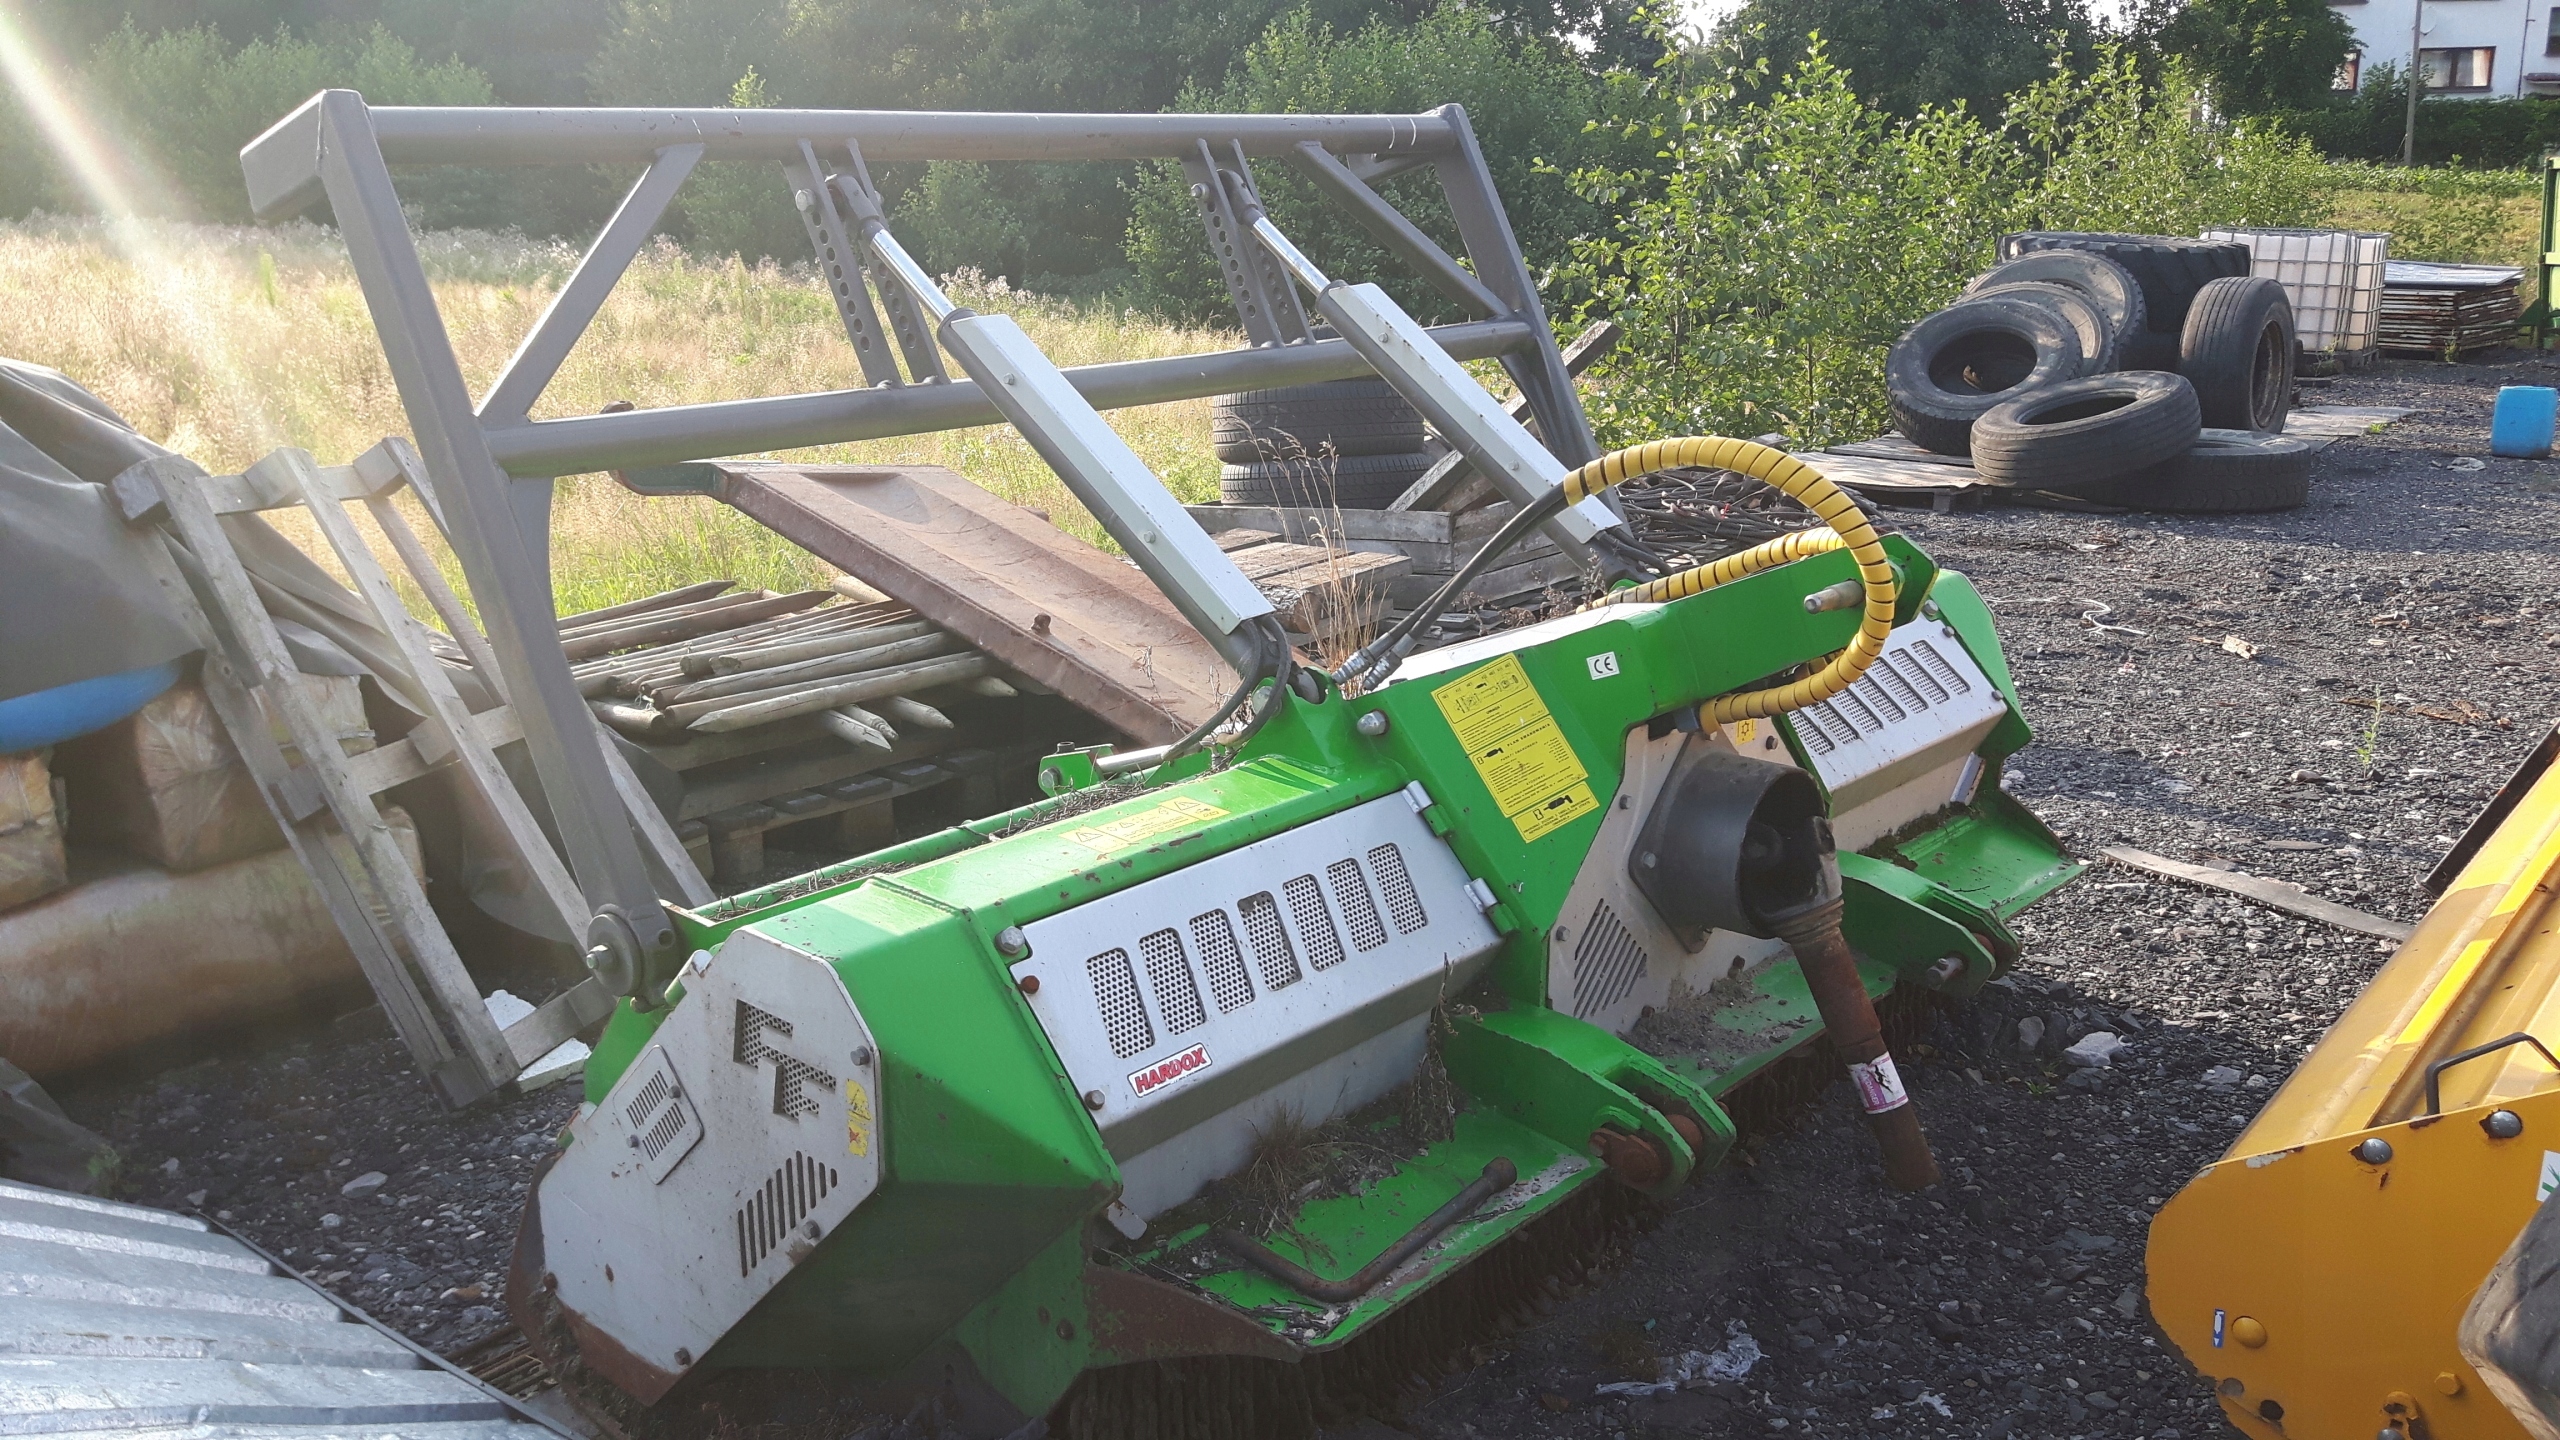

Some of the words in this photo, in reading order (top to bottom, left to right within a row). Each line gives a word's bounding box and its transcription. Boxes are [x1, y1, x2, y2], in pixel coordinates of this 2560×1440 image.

[1594, 656, 1613, 673] CE
[1506, 738, 1519, 747] PLAN
[1135, 1047, 1207, 1093] HARDOX
[1865, 1080, 1879, 1105] DANGER
